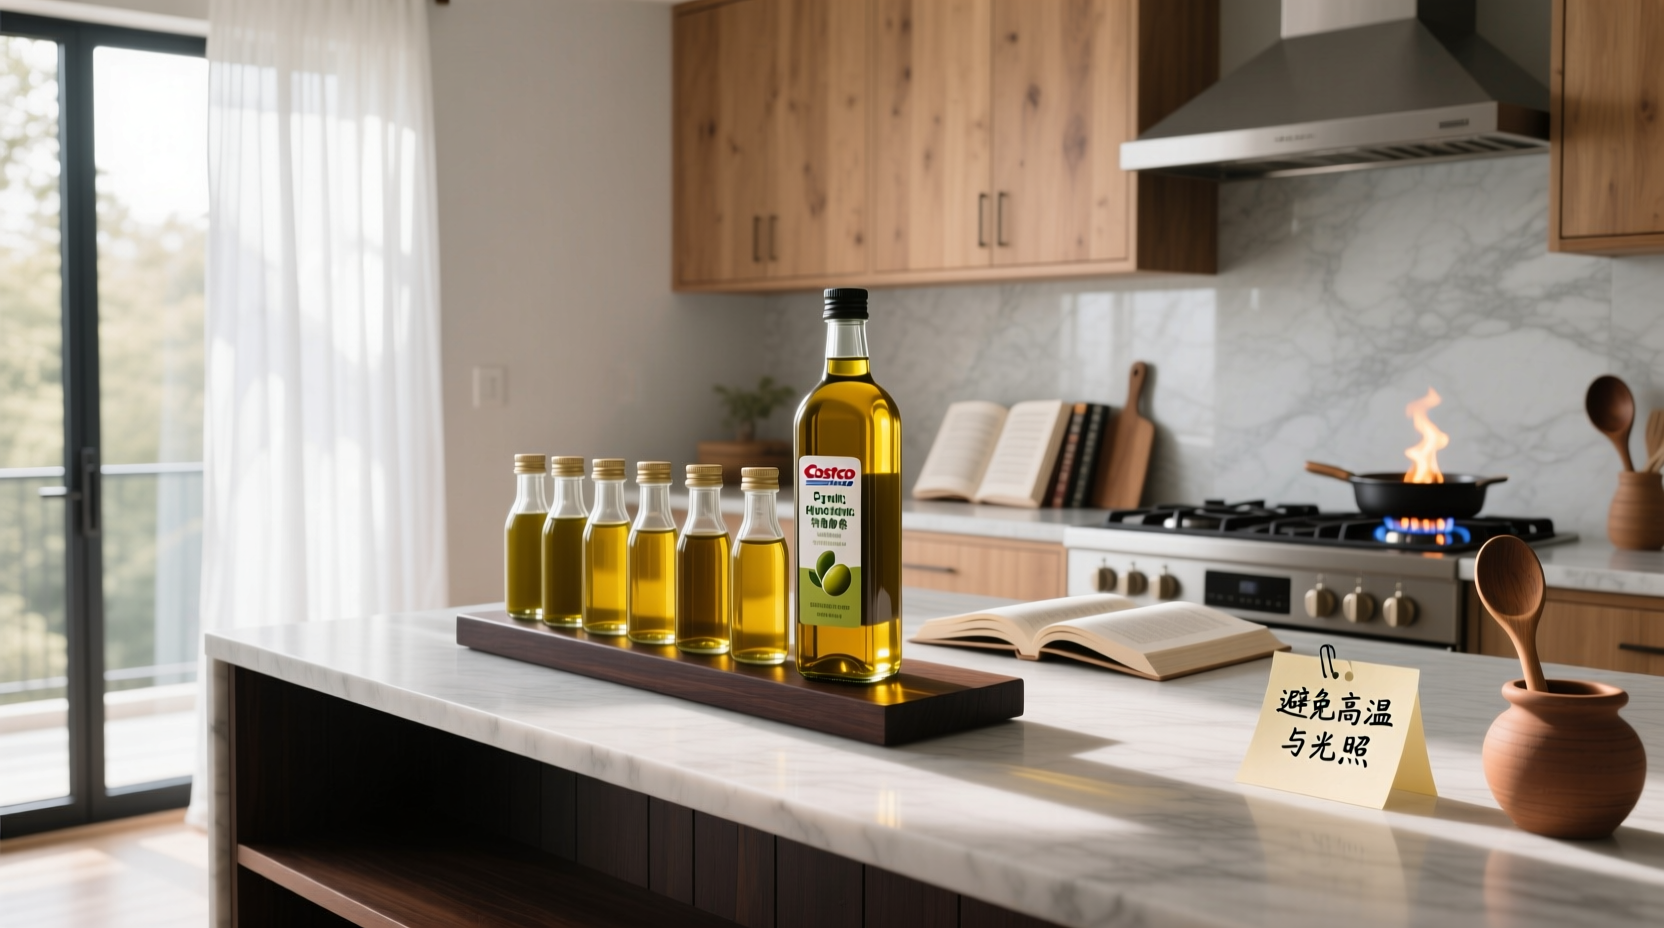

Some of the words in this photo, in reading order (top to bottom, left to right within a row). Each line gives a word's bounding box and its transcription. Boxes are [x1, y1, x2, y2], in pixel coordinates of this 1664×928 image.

[804, 464, 856, 480] Costco
[1276, 686, 1394, 727] 避免高温
[1281, 727, 1371, 768] 与光照
